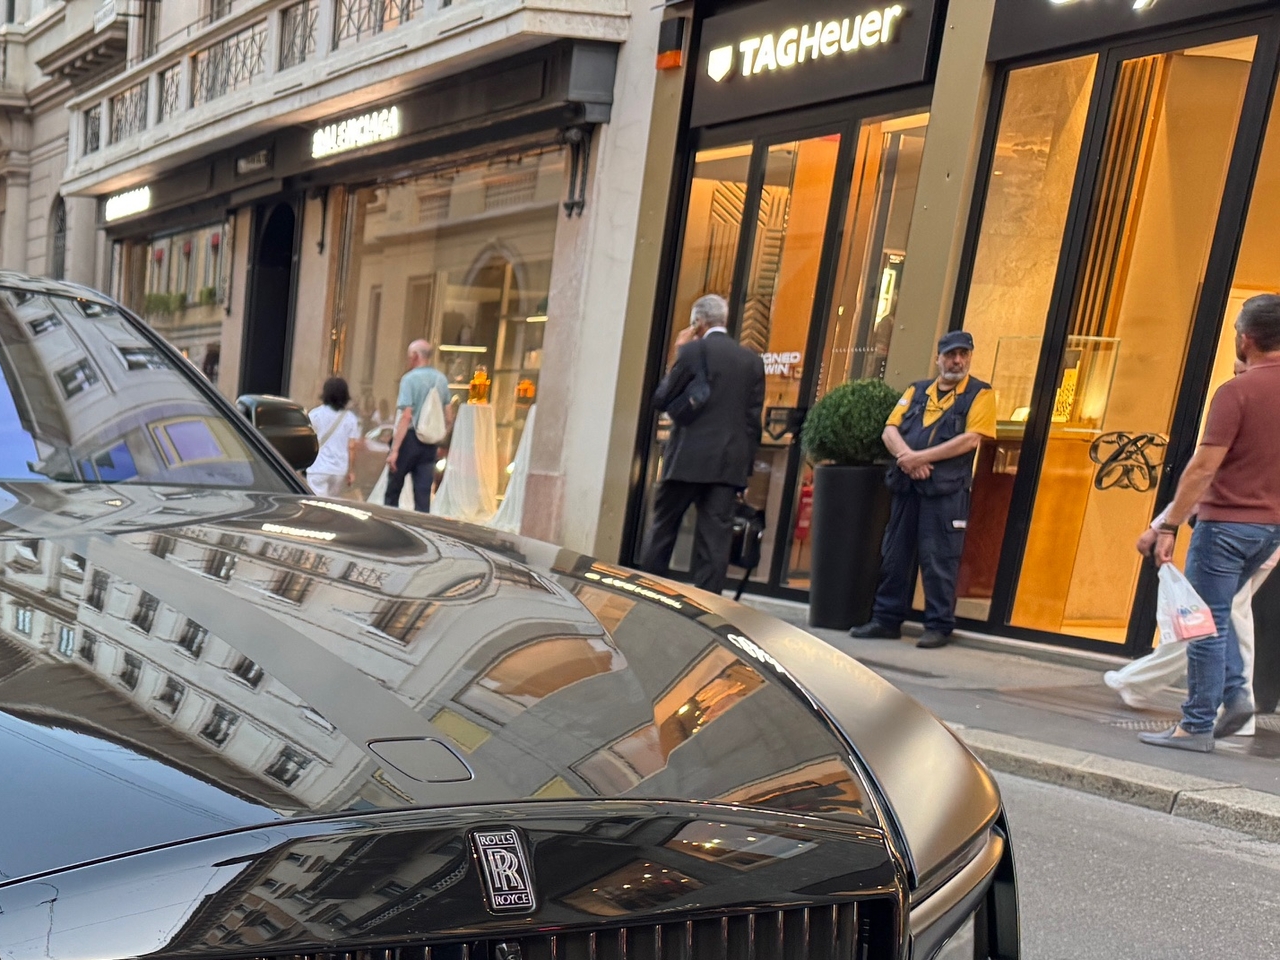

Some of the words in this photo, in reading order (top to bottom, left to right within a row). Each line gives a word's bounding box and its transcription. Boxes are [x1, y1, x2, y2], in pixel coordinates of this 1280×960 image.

[764, 363, 789, 375] WIN
[480, 834, 514, 845] ROLLS
[495, 894, 529, 905] ROYCE
